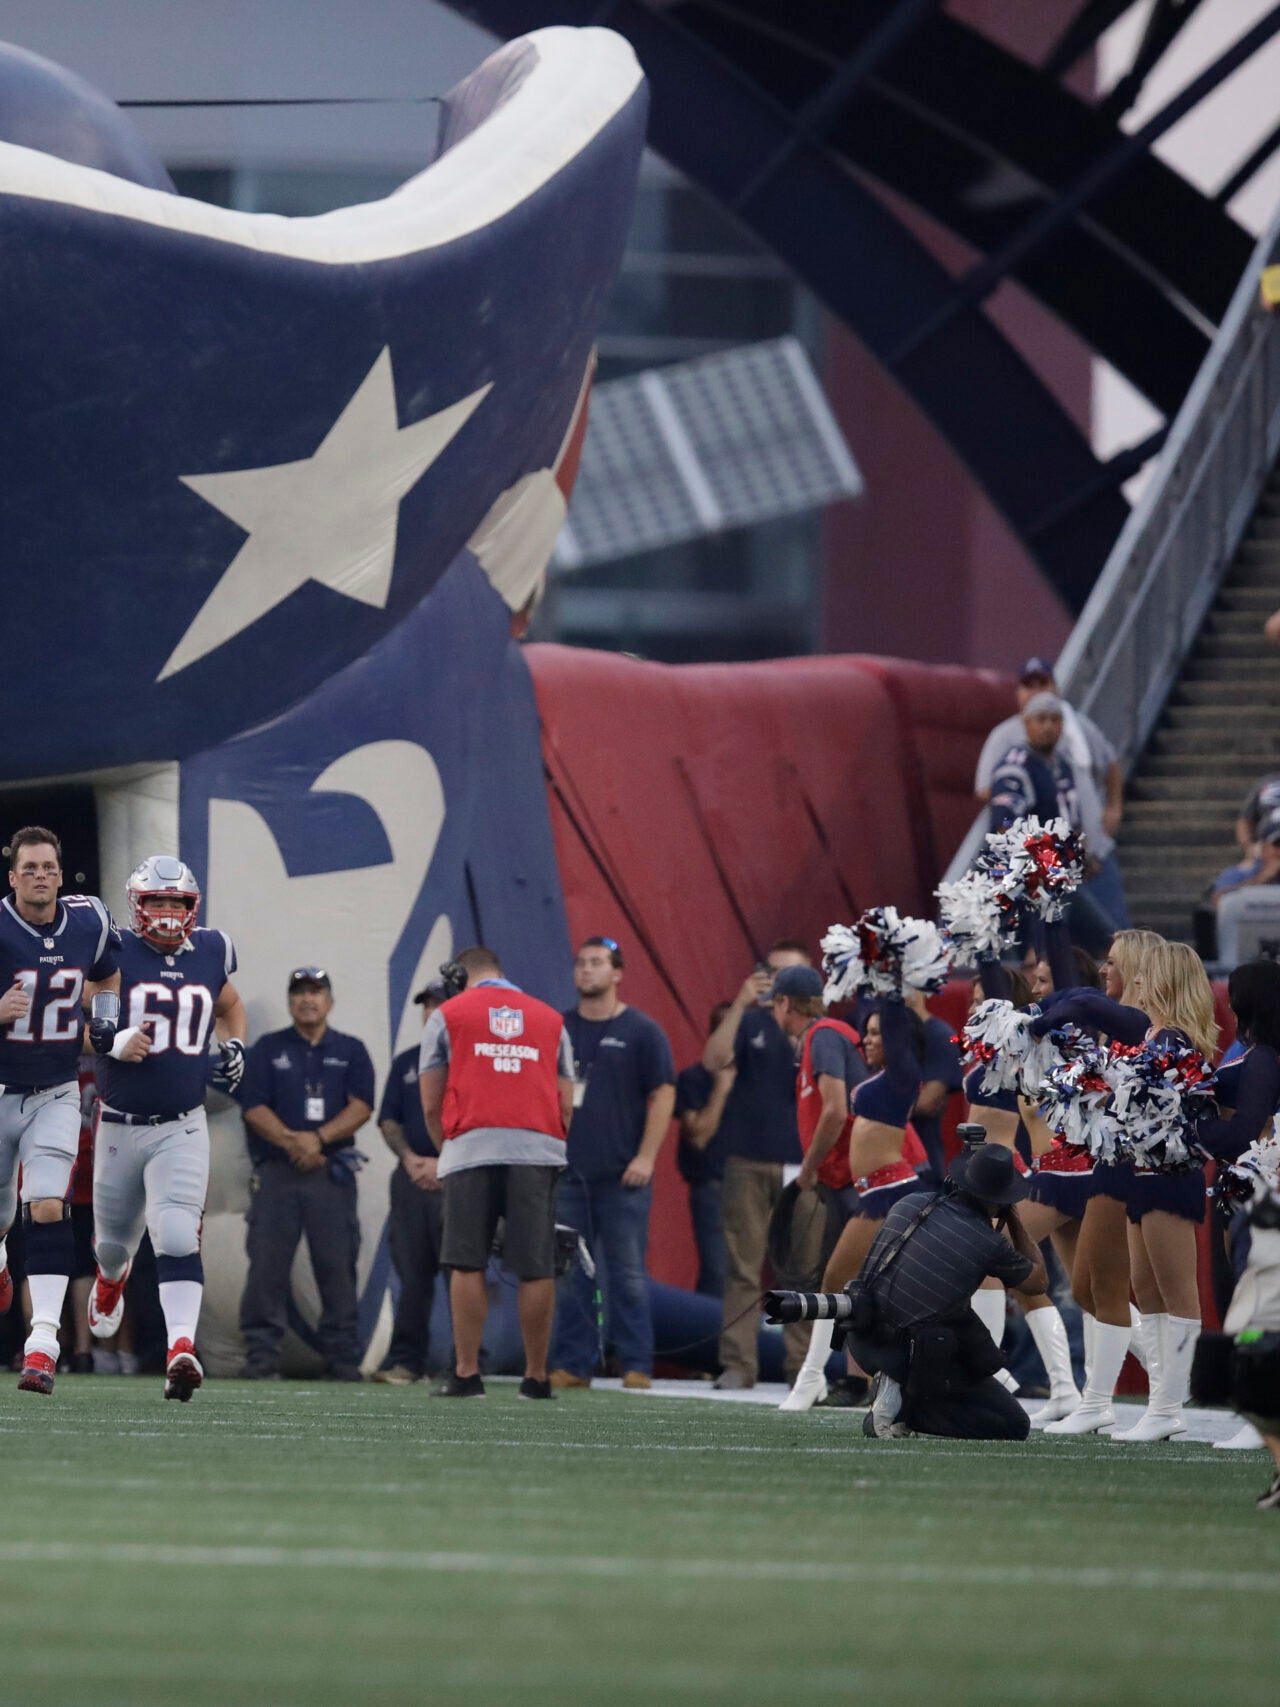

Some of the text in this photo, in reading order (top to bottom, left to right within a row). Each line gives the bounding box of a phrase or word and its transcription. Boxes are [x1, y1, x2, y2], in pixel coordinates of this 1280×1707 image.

[6, 967, 84, 1042] 12
[129, 982, 214, 1056] 60
[474, 1043, 539, 1062] PRESEASON
